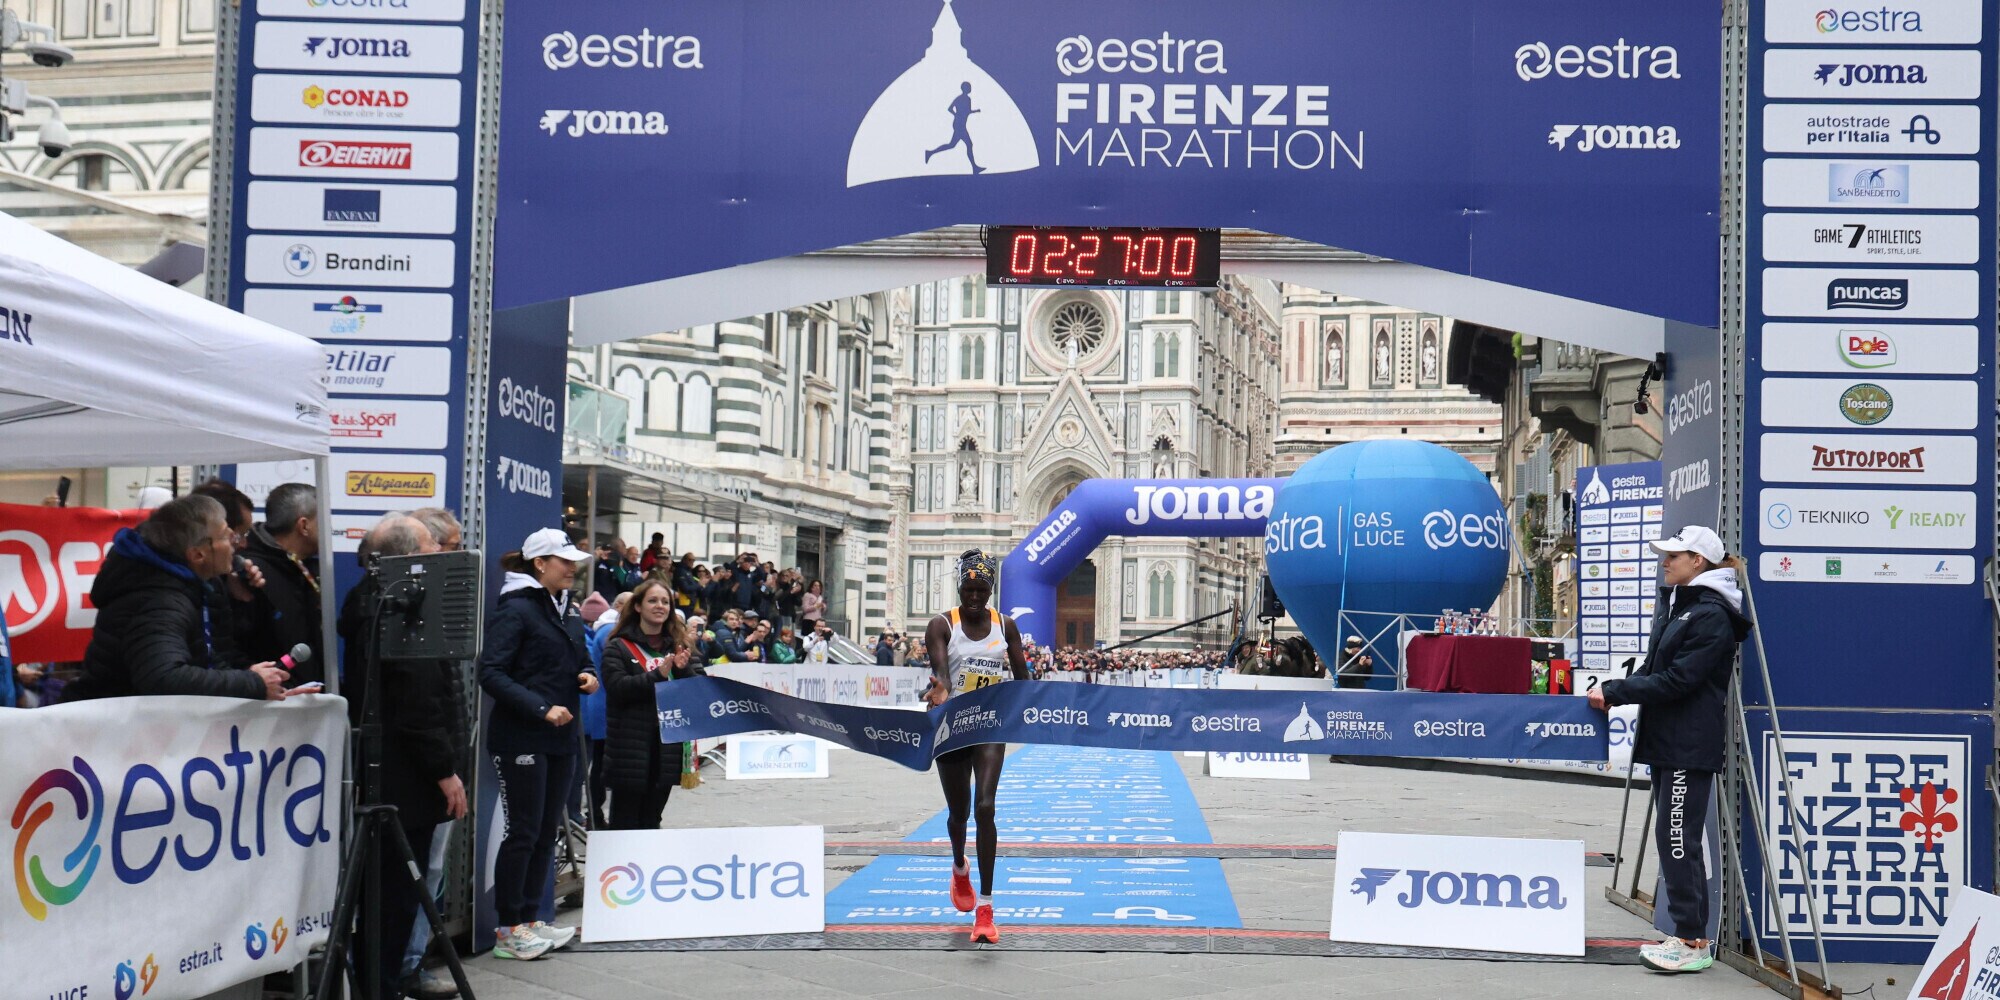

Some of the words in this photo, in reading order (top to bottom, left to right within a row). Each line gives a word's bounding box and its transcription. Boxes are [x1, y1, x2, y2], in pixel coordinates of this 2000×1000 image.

[1841, 6, 1923, 32] estra
[327, 37, 411, 58] Joma
[580, 27, 703, 69] estra
[1097, 31, 1227, 74] estra
[1554, 37, 1681, 79] estra
[1839, 64, 1928, 87] Joma
[326, 88, 409, 108] CONAD
[1056, 83, 1330, 126] FIRENZE
[568, 109, 668, 137] Joma
[1807, 116, 1890, 128] autostrade
[1577, 124, 1681, 152] Joma
[1807, 132, 1835, 145] per
[1055, 128, 1364, 170] MARATHON
[327, 210, 377, 221] FANFANI
[1814, 229, 1843, 243] GAME
[1843, 224, 1866, 248] 7
[1867, 230, 1921, 244] ATHLETICS
[326, 253, 410, 271] Brandini
[1011, 235, 1196, 275] 02:27:00
[1834, 284, 1902, 301] nuncas
[1849, 336, 1888, 353] Dole
[326, 350, 396, 372] etilar
[334, 375, 385, 388] moving
[512, 384, 556, 433] estra
[1678, 378, 1712, 428] estra
[1845, 397, 1888, 409] Toscano
[360, 411, 397, 430] Sport
[1812, 445, 1925, 469] TUTTOSPORT
[351, 474, 430, 494] Artigianale
[1620, 475, 1646, 487] estra
[1612, 486, 1663, 502] FIRENZE
[1125, 485, 1274, 525] Joma
[1354, 512, 1393, 528] GAS
[1798, 510, 1869, 525] TEKNIKO
[1910, 512, 1966, 527] READY
[1354, 530, 1405, 547] LUCE
[1460, 509, 1508, 551] est
[1621, 657, 1636, 679] 1
[871, 676, 889, 697] CONAD
[1586, 675, 1598, 691] 2
[725, 698, 771, 716] estra
[1039, 706, 1089, 726] estra
[1334, 710, 1363, 721] estra
[951, 718, 1002, 737] MARATHON
[952, 710, 997, 729] FIRENZE
[1120, 711, 1173, 728] Joma
[1208, 715, 1261, 734] estra
[1326, 720, 1386, 731] FIRENZE
[1430, 718, 1486, 738] estra
[876, 726, 922, 748] estra
[1326, 730, 1393, 741] MARATHON
[1540, 722, 1597, 738] Joma
[1778, 752, 1948, 794] FIRE
[111, 725, 330, 884] estra
[1778, 795, 1906, 837] NZE
[1779, 840, 1949, 882] MARA
[650, 854, 810, 902] estra
[1397, 869, 1567, 910] Joma
[1779, 884, 1949, 927] THON
[179, 942, 223, 974] estra.it
